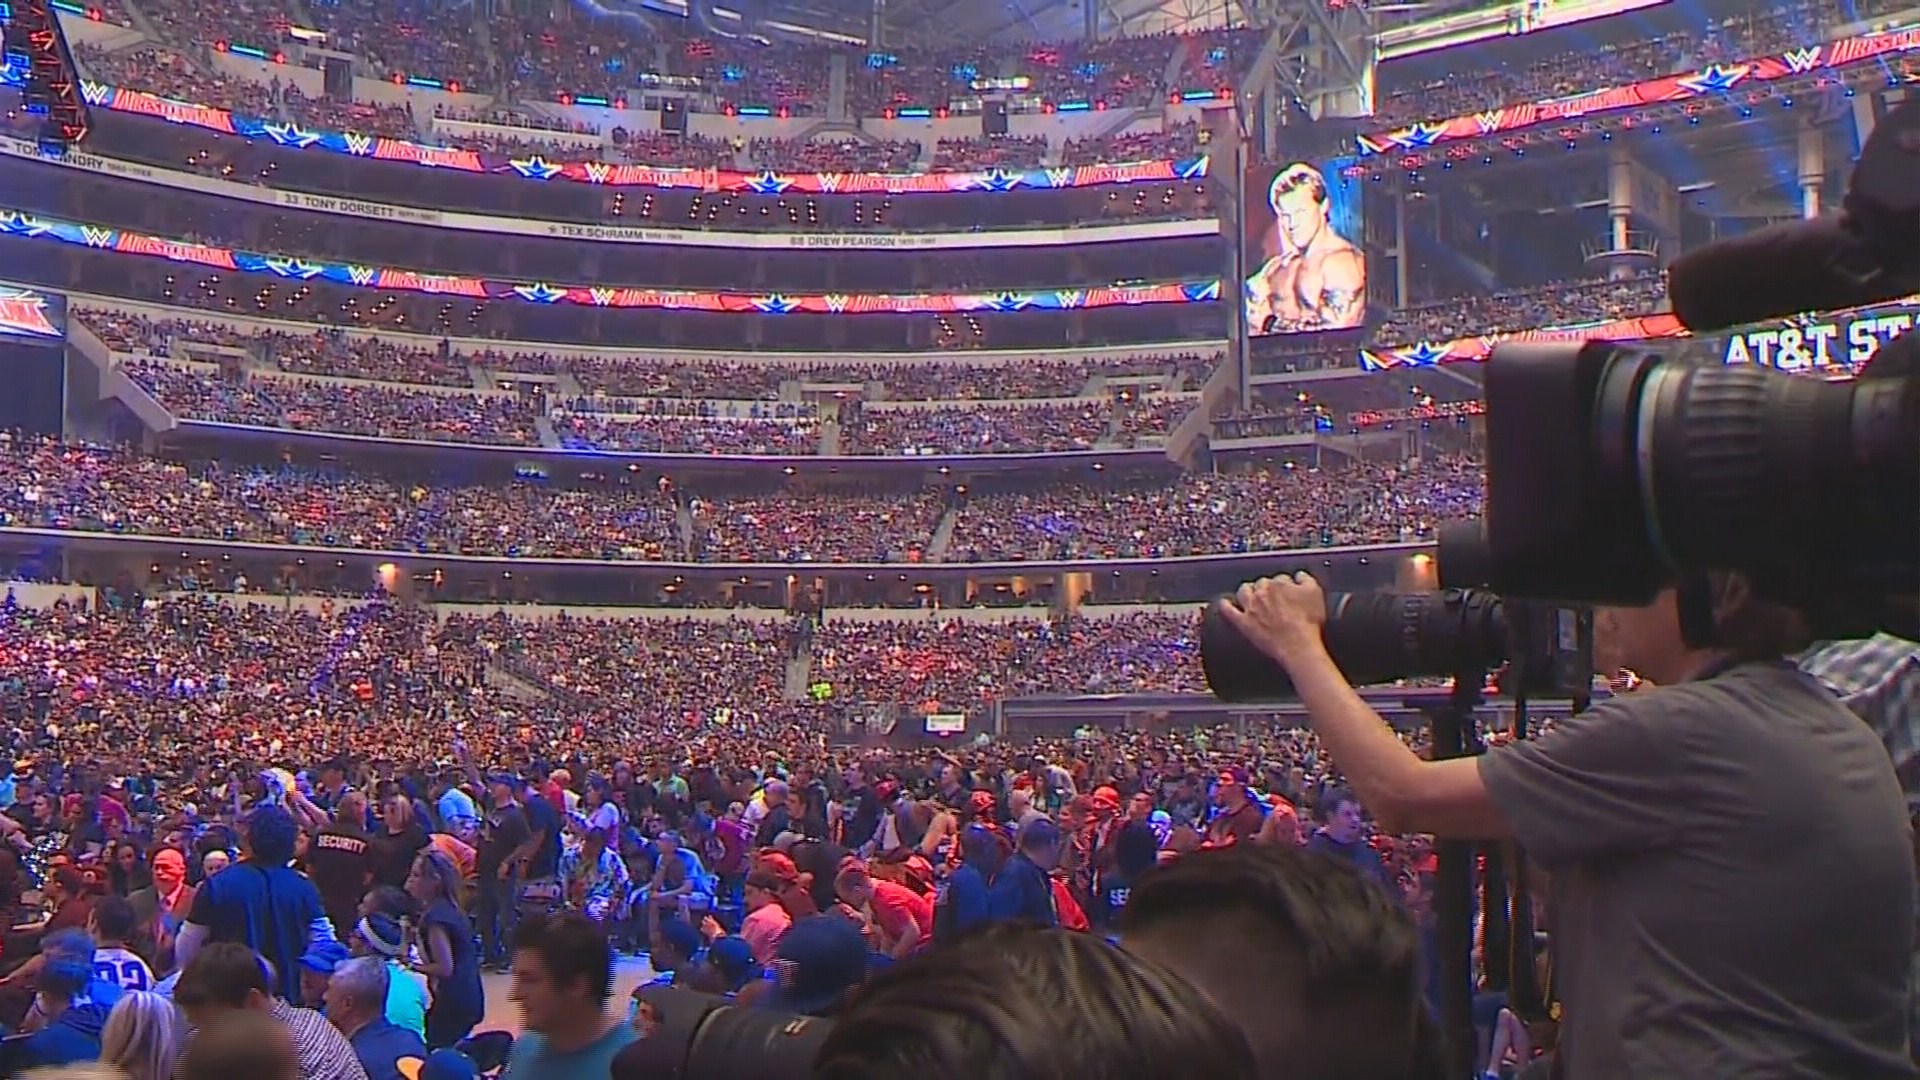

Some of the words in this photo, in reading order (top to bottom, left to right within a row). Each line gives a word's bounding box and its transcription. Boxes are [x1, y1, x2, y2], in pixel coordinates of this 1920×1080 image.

[304, 196, 337, 209] TONY
[339, 201, 394, 216] DORSETT
[561, 225, 583, 236] TEX
[586, 228, 644, 240] SCHRAMM
[808, 236, 841, 246] DREW
[843, 237, 896, 247] PEARSON
[1725, 323, 1838, 370] AT&T
[1848, 314, 1920, 363] ST
[317, 834, 367, 854] SECURITY
